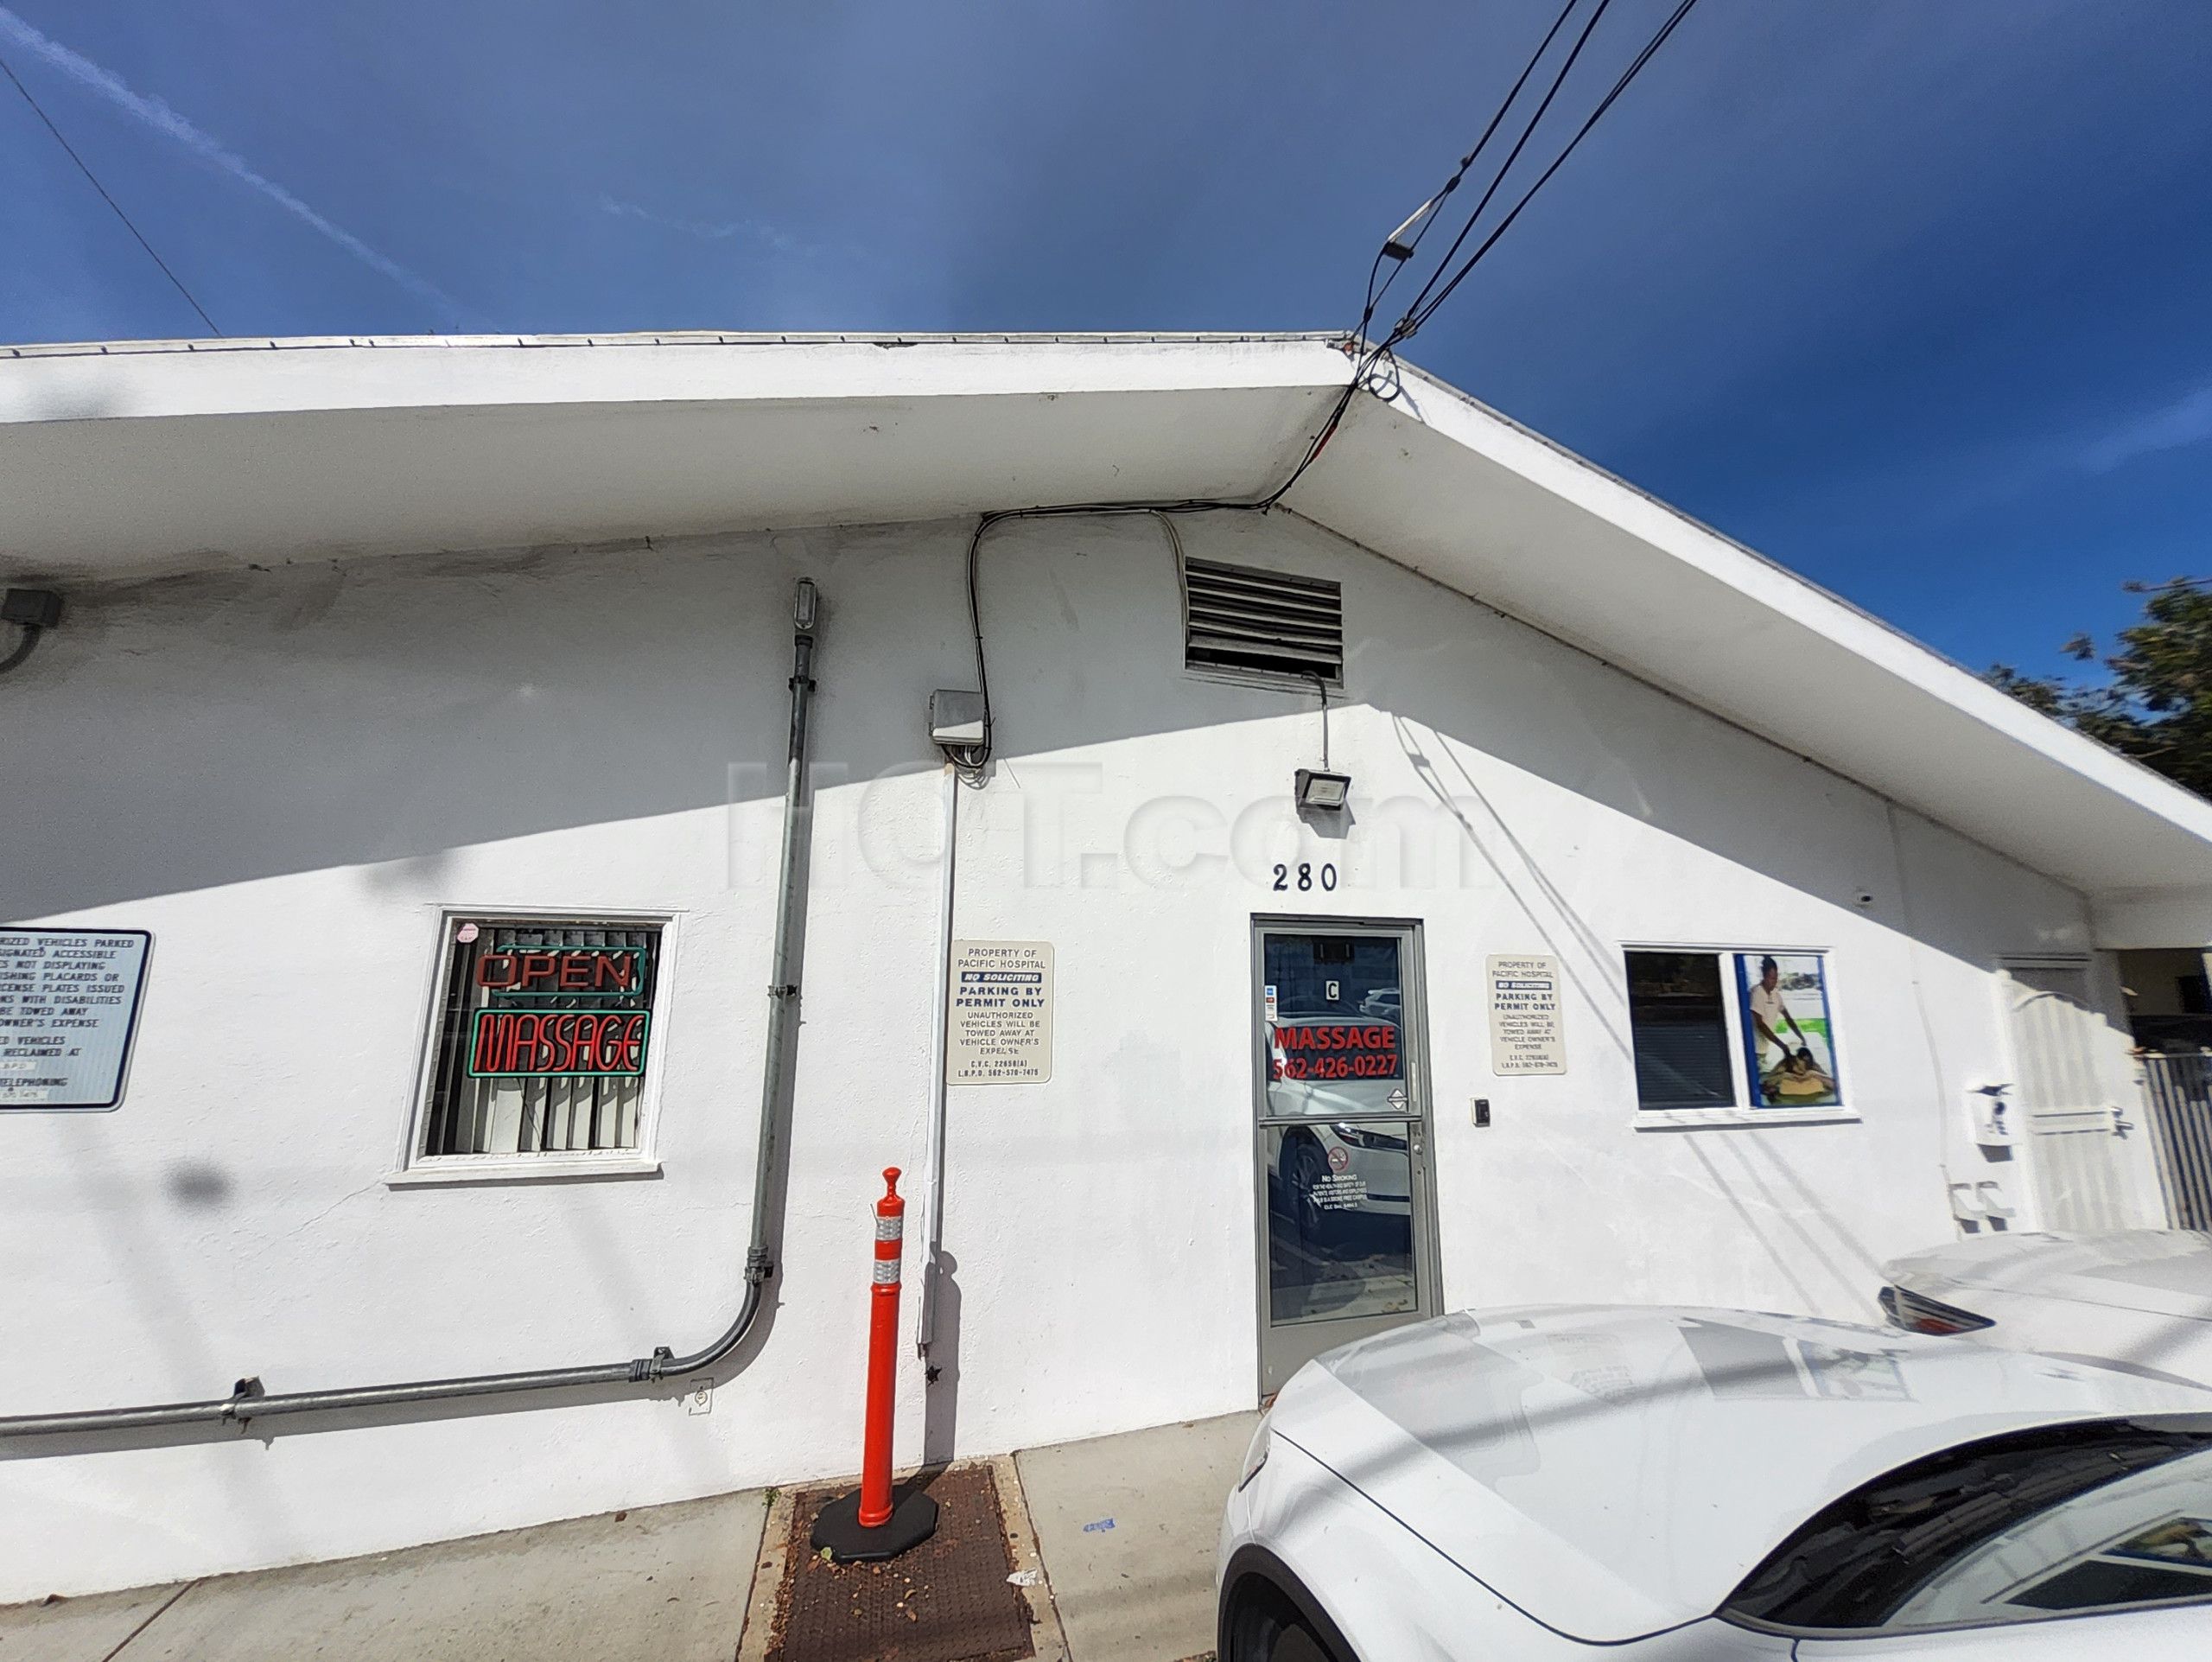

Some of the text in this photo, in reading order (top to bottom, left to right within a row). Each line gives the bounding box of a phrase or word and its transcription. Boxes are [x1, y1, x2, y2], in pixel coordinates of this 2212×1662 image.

[1273, 863, 1337, 891] 280
[37, 939, 87, 947] VEHICLES
[53, 951, 116, 959] ACCESSIBLE
[958, 959, 1046, 969] PACIFIC HOSPITAL
[477, 954, 631, 988] OPEN
[983, 973, 1039, 982] SOLICITING
[41, 984, 79, 993] PLATES
[960, 987, 1019, 996] PARKING
[1328, 983, 1337, 998] C
[956, 998, 1006, 1007] PERMIT
[51, 1019, 99, 1028] EXPENSE
[474, 1014, 645, 1072] MASSAGE
[1274, 1027, 1395, 1050] MASSAGE
[1273, 1054, 1397, 1079] 562-426-0227
